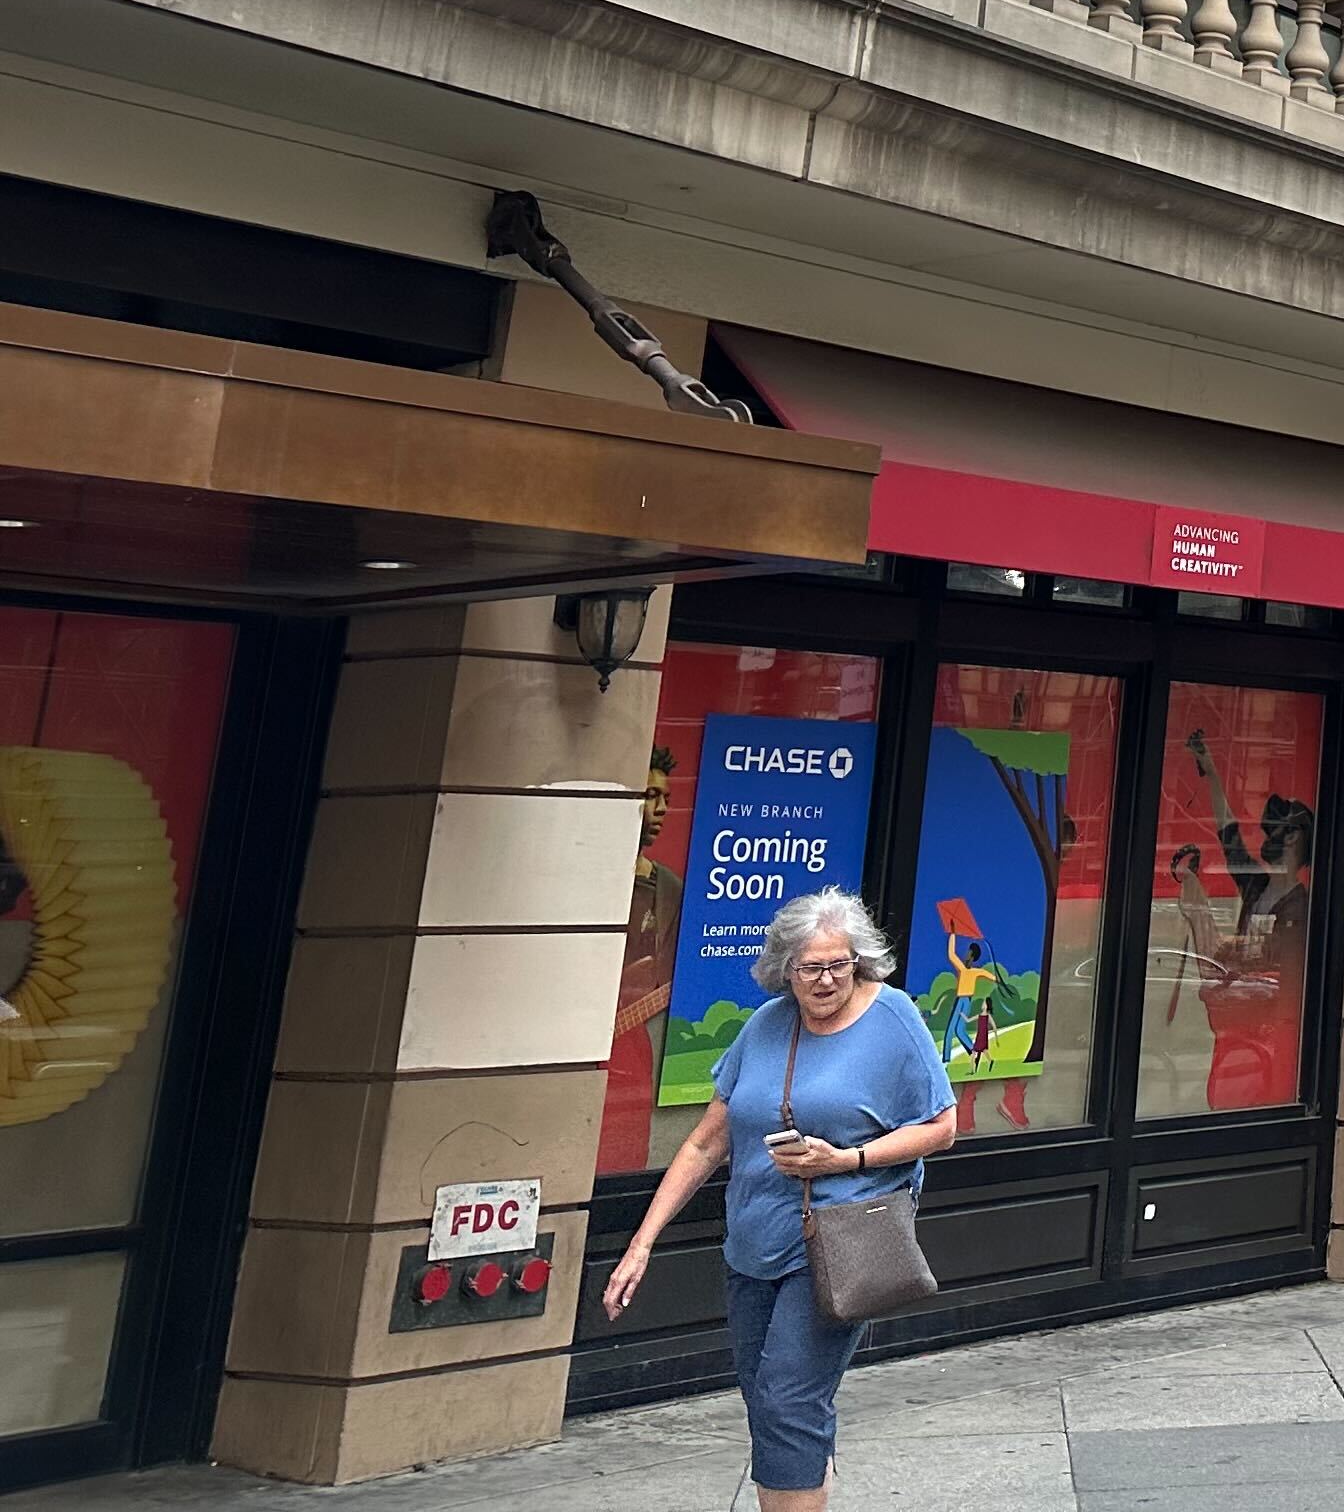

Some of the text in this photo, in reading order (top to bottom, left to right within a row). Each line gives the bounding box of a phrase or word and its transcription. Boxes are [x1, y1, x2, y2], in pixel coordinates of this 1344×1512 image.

[1174, 524, 1239, 544] ADVANCING
[1172, 540, 1216, 558] HUMAN
[724, 745, 825, 775] CHASE
[718, 803, 824, 819] NEW BRANCH
[712, 829, 828, 873] Coming
[706, 868, 784, 900] Soon
[702, 923, 770, 937] Learn more
[450, 1200, 519, 1236] FDC
